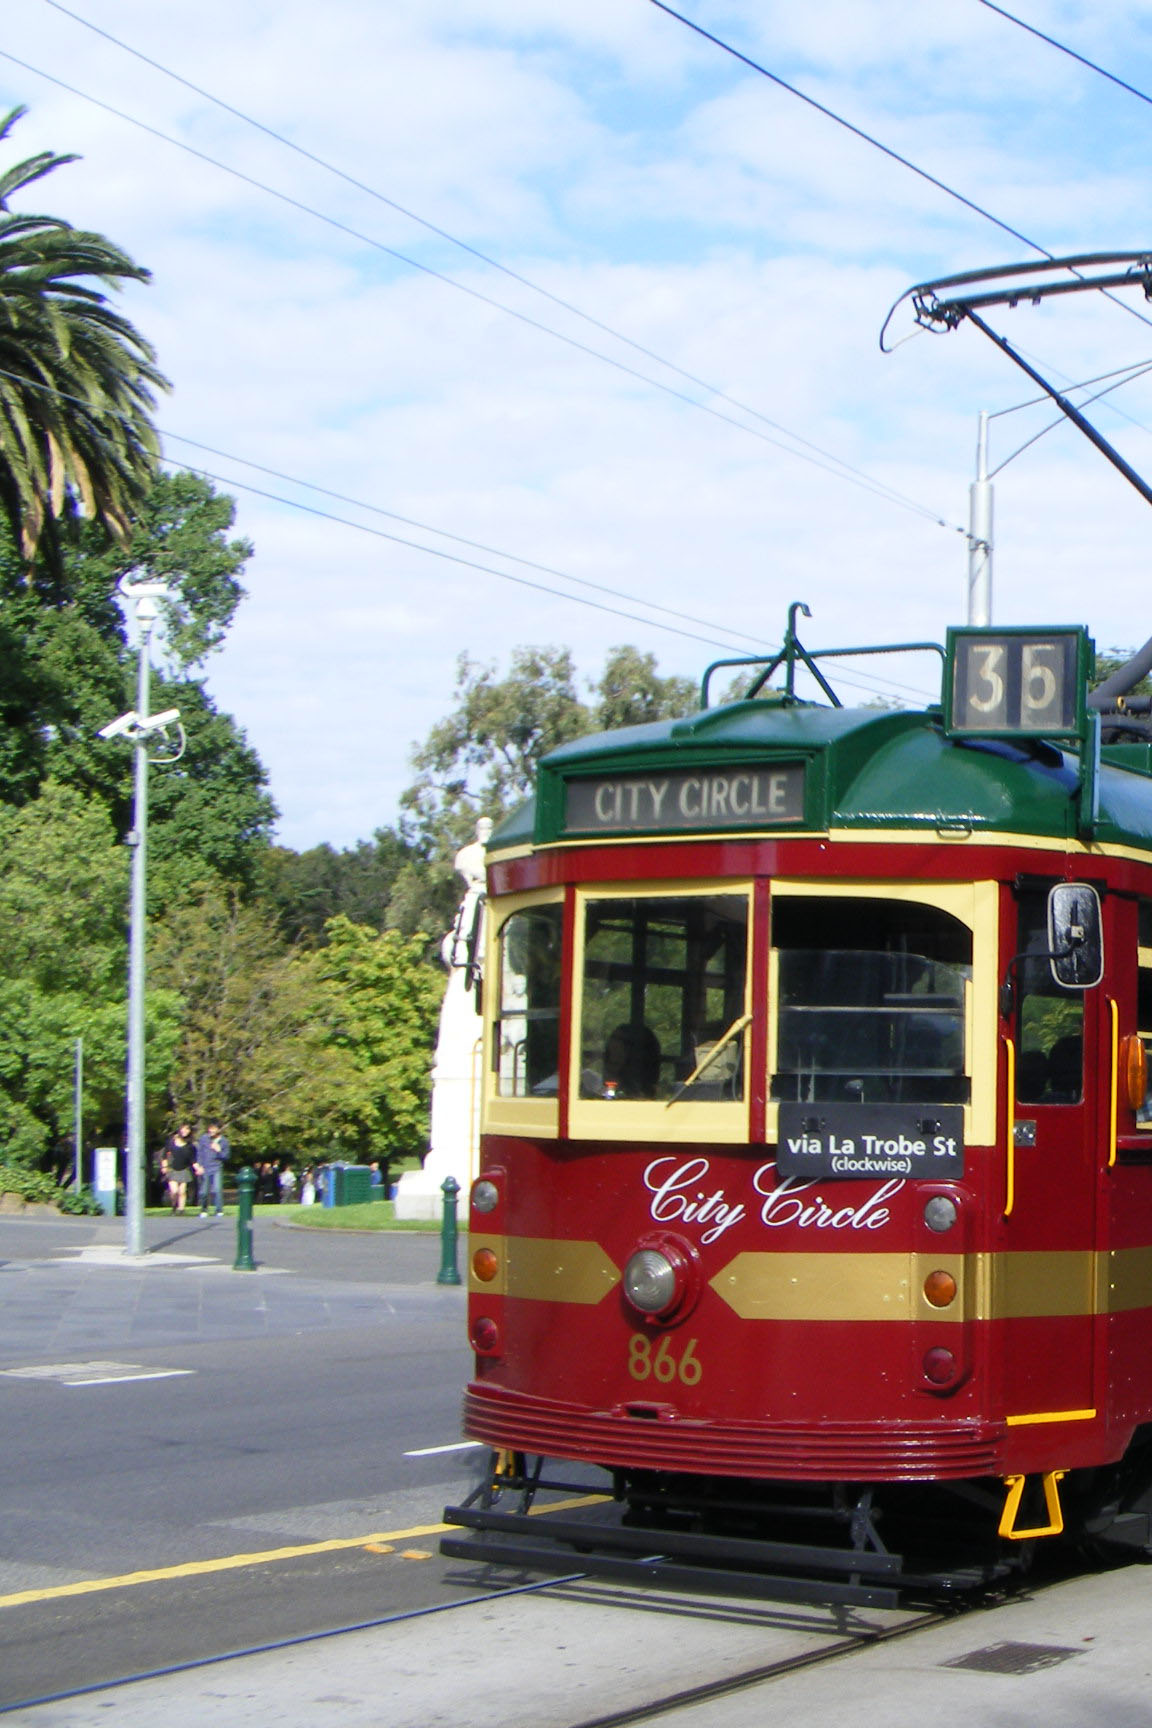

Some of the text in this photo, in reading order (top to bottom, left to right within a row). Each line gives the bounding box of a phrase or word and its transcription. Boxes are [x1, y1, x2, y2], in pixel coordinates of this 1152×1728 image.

[969, 643, 1056, 713] 35
[595, 774, 786, 821] CITY CIRCLE
[787, 1134, 957, 1156] via La Trobe St
[831, 1156, 912, 1173] (clockwise)
[643, 1157, 906, 1245] City Circle
[628, 1333, 702, 1386] 866
